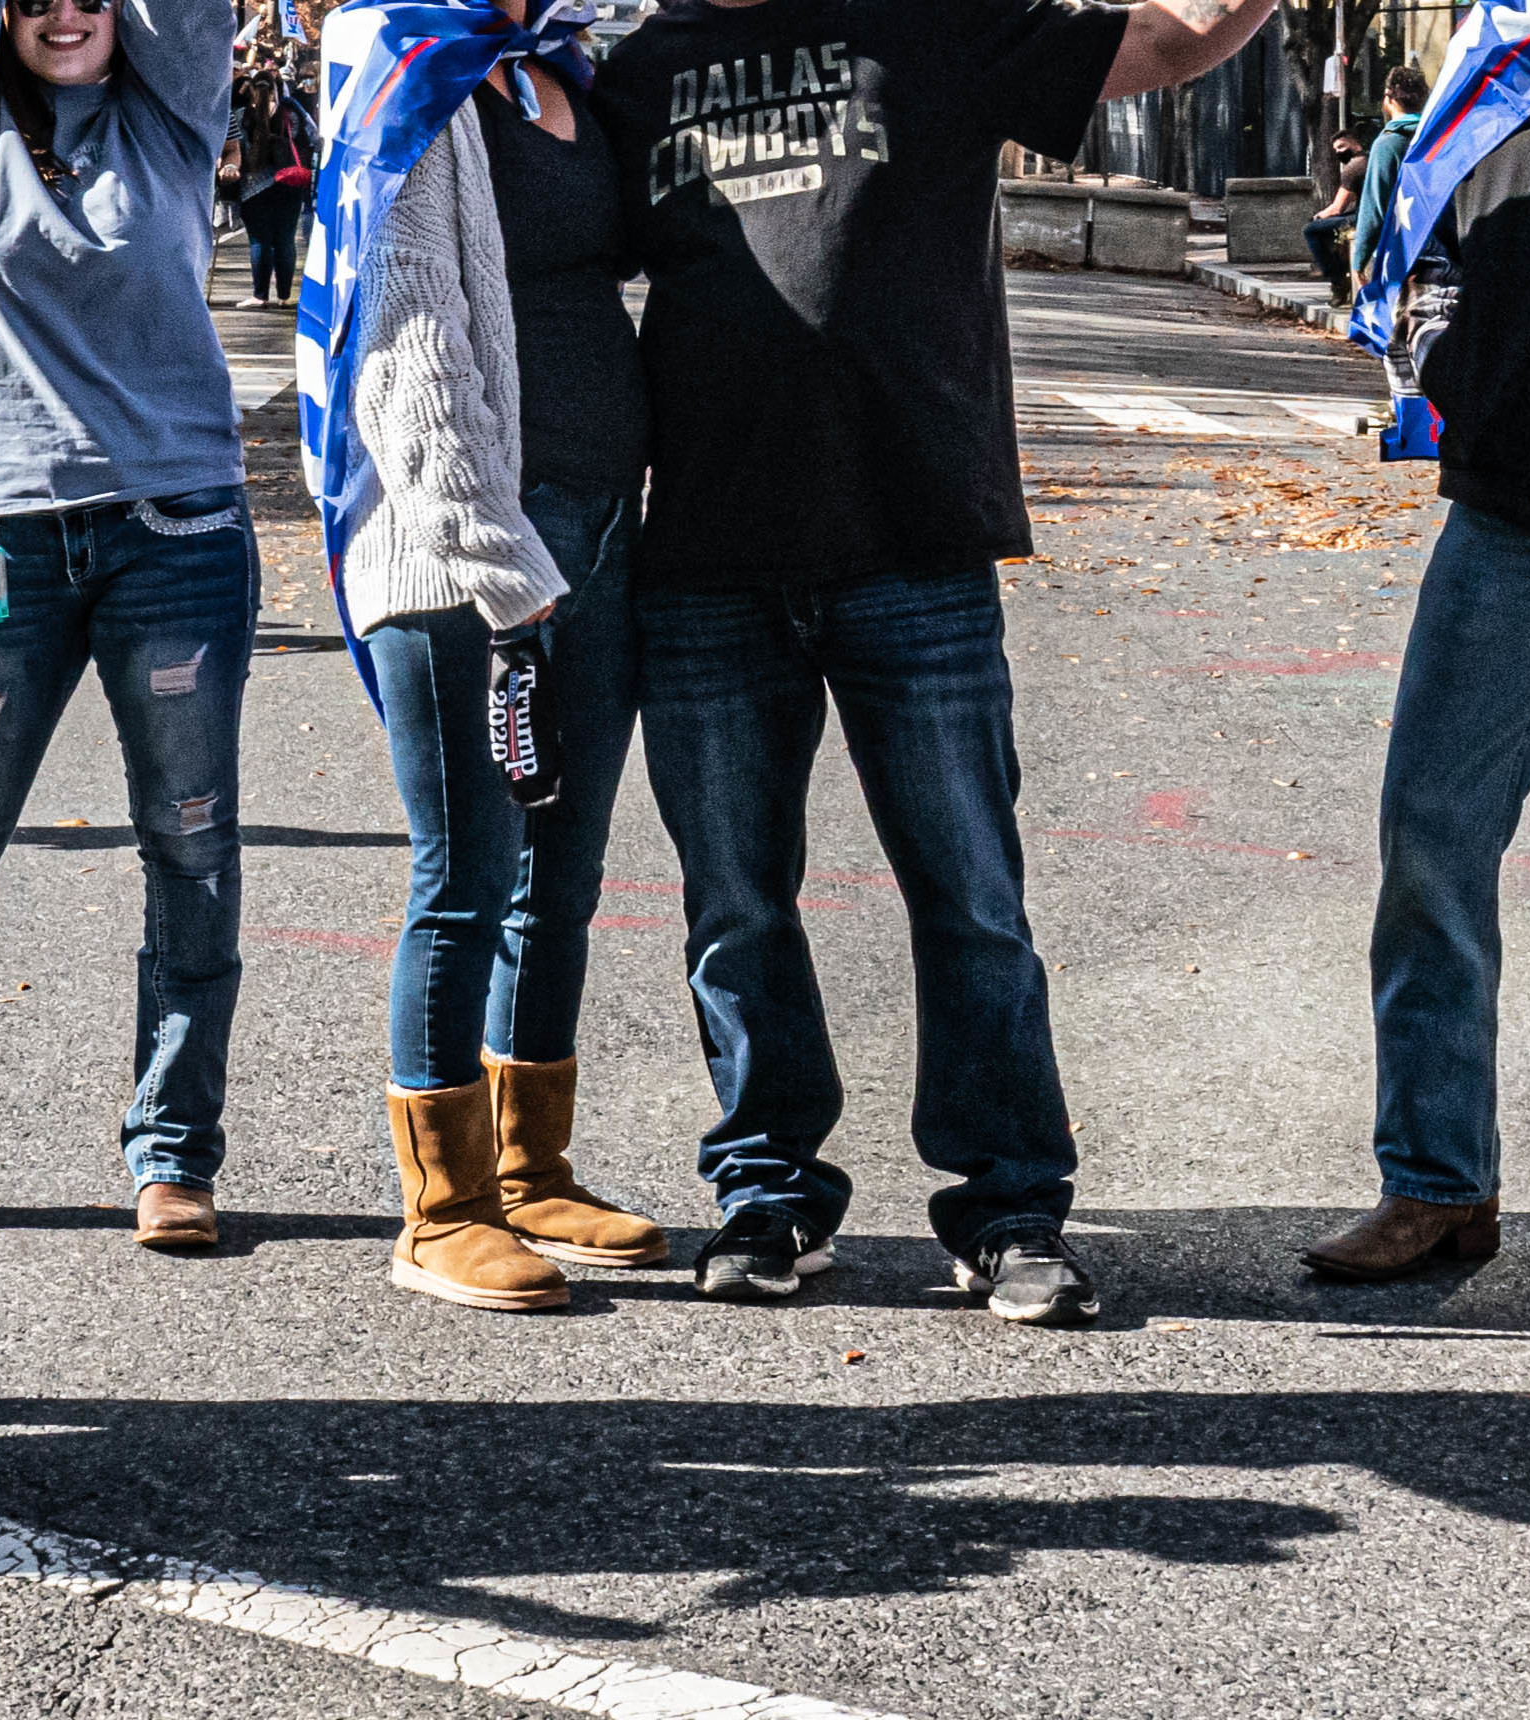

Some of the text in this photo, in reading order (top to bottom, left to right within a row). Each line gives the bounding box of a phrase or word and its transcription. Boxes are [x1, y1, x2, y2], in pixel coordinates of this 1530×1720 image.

[670, 42, 852, 126] DALLAS
[649, 100, 889, 207] COWBOYS
[488, 689, 509, 762] 2020
[505, 664, 538, 776] Trump
